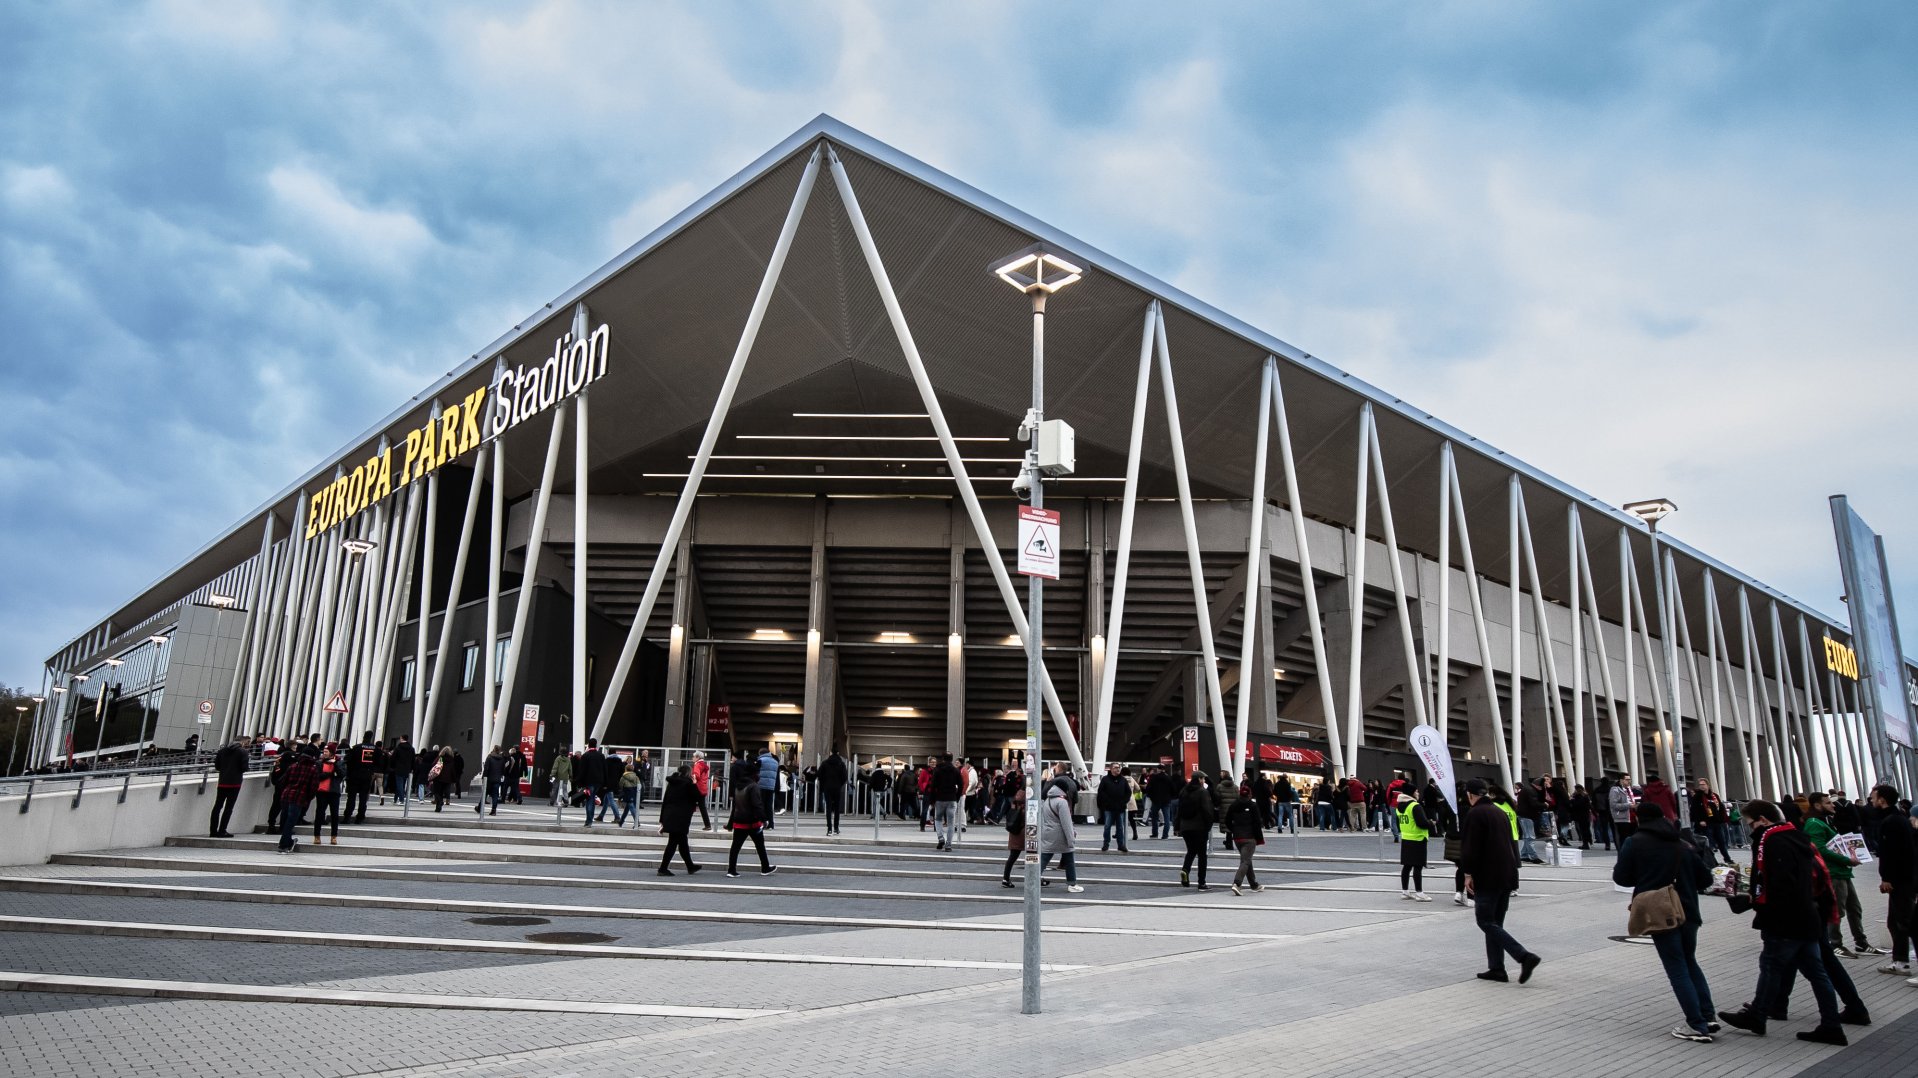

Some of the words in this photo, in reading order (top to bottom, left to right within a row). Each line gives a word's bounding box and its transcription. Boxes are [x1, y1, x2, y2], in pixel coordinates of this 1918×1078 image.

[305, 446, 393, 540] EUROPA
[400, 386, 487, 486] PARK
[492, 323, 612, 437] Stadion
[1823, 636, 1858, 681] EURO
[525, 710, 537, 719] E2
[1185, 730, 1197, 740] E2
[1279, 750, 1303, 762] TICKETS
